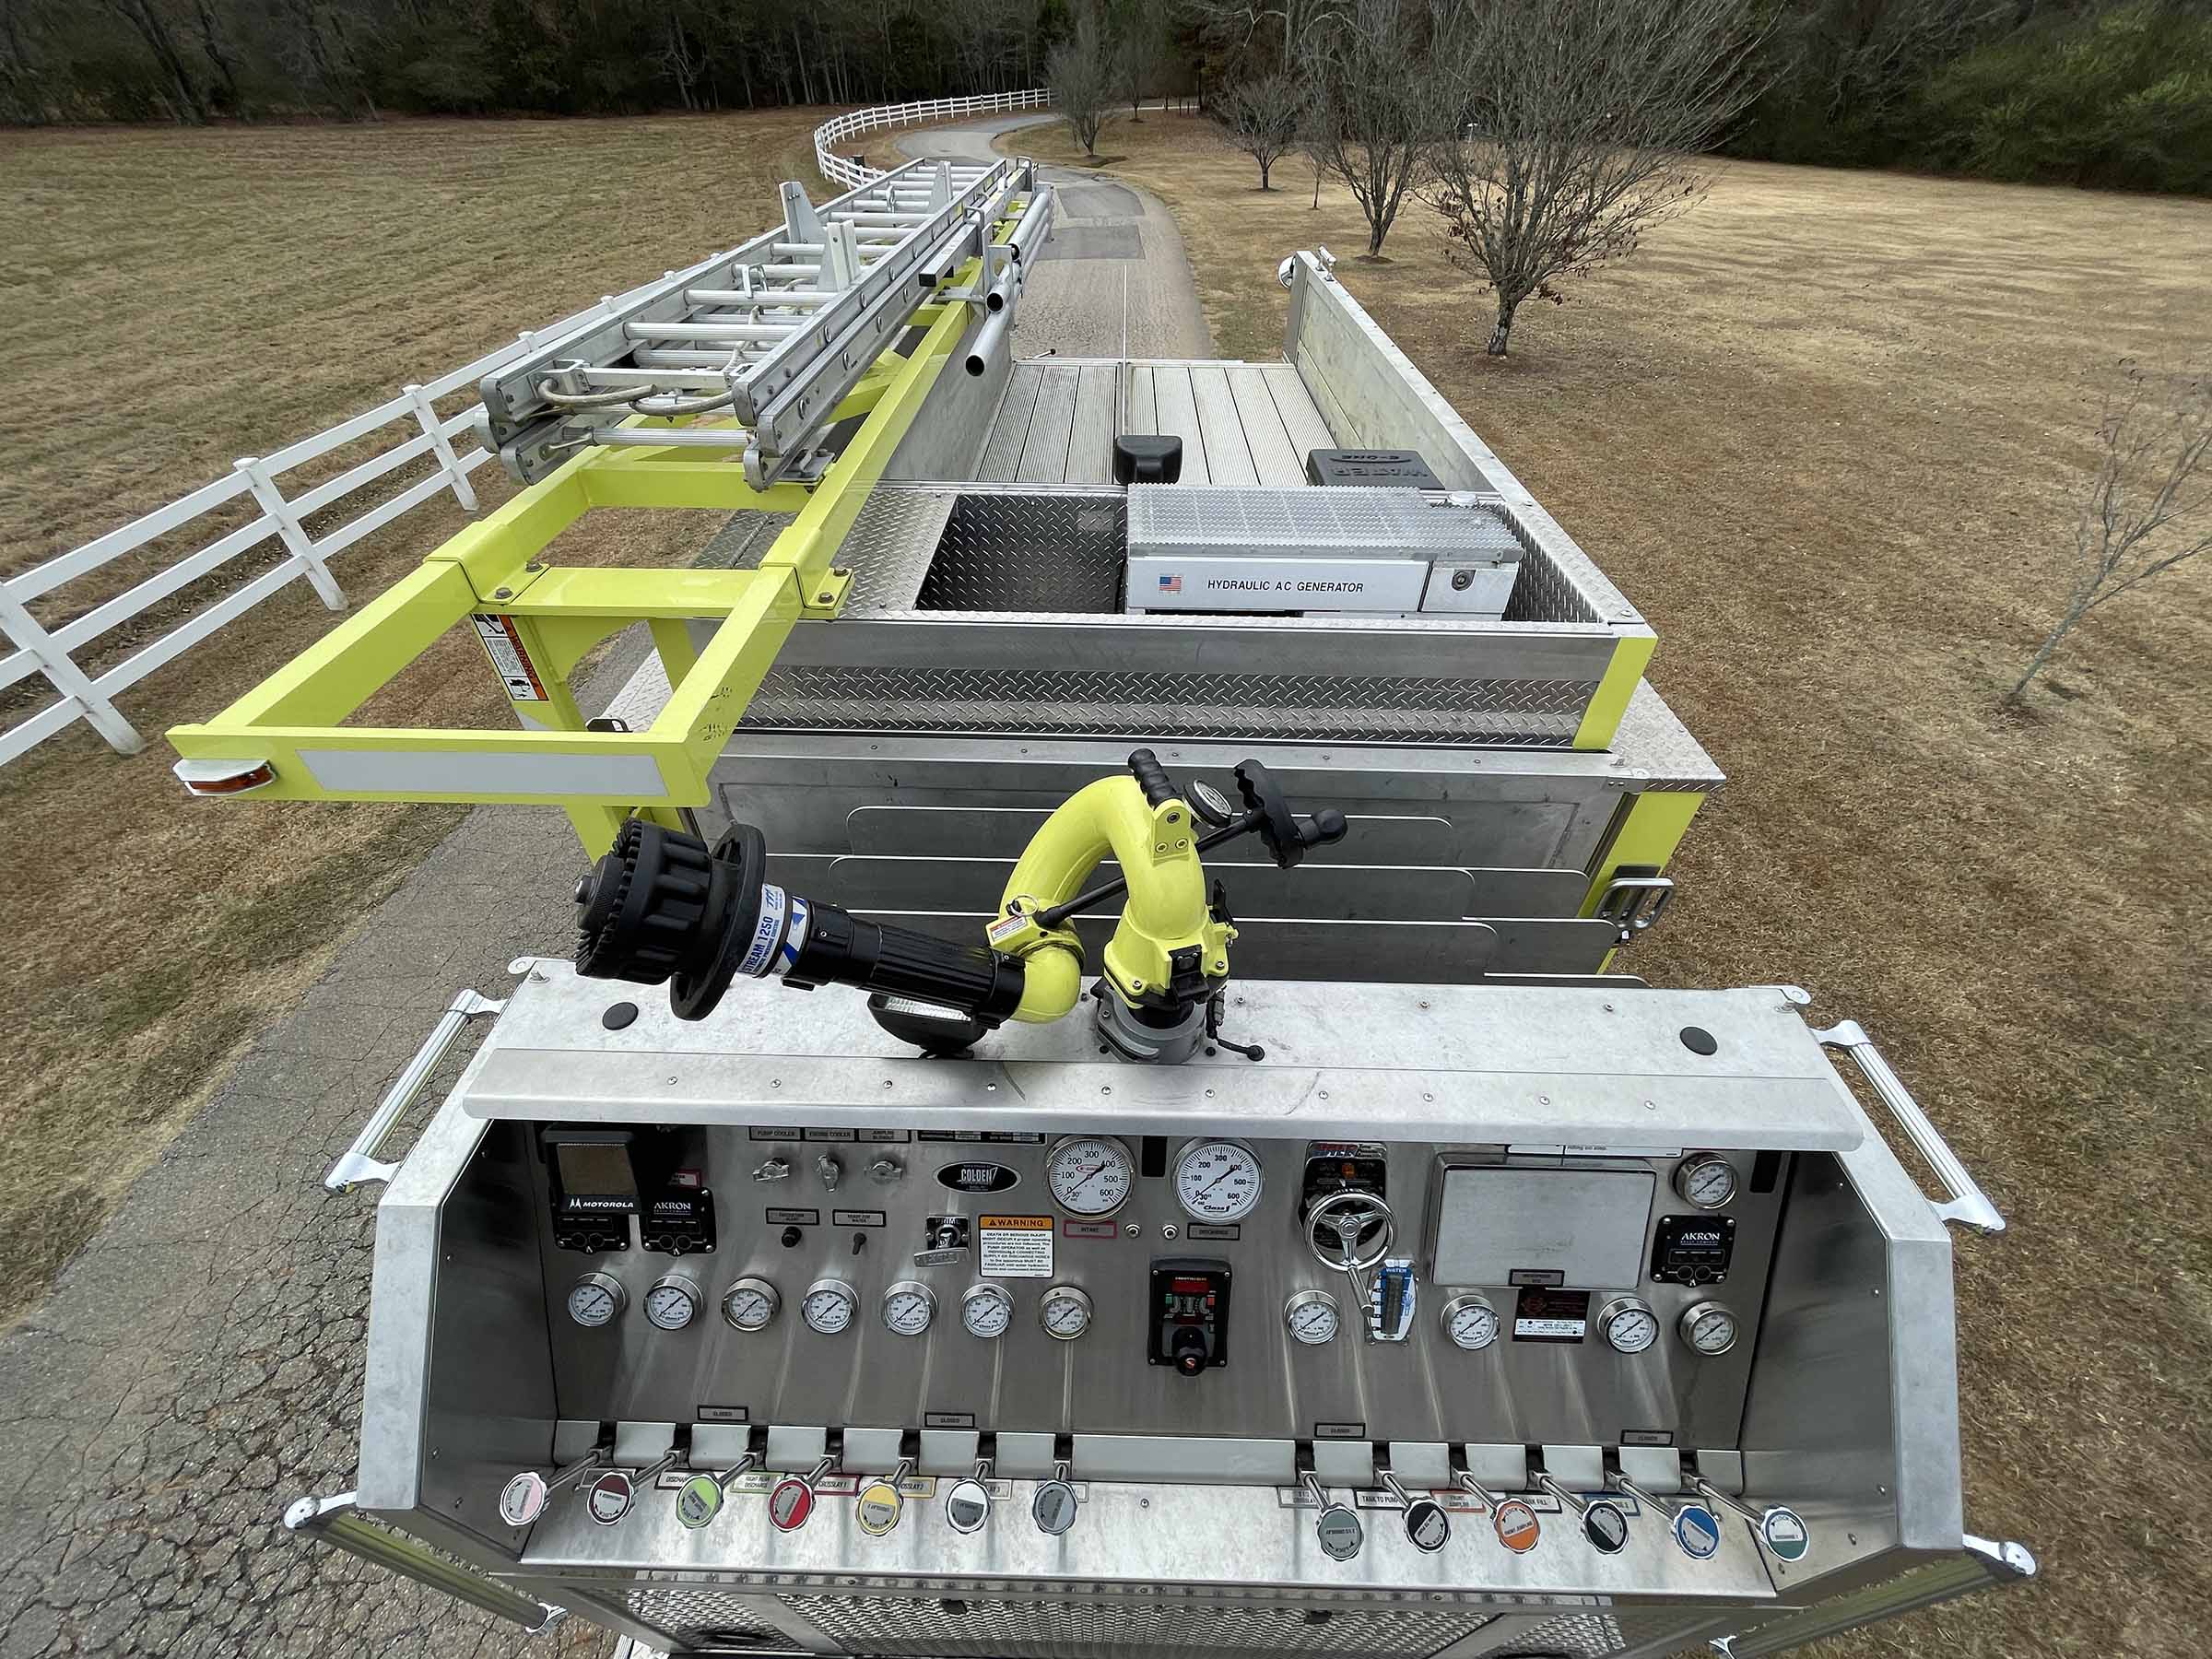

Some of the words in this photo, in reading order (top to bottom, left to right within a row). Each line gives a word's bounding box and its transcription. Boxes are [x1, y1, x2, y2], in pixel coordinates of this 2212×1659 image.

[1206, 579, 1270, 591] HYDRAULIC
[1275, 581, 1292, 591] AC
[1297, 582, 1364, 593] GENERATOR
[508, 635, 535, 679] WARNING
[741, 943, 766, 972] STREAM
[757, 916, 774, 941] 1250
[1084, 1150, 1099, 1159] 300
[1067, 1157, 1082, 1165] 200
[1103, 1175, 1118, 1183] 500
[1233, 1178, 1247, 1186] 500
[1099, 1188, 1113, 1196] 600
[653, 1202, 692, 1211] AKRON
[1681, 1232, 1721, 1241] AKRON
[1362, 1495, 1376, 1503] TANK
[1505, 1507, 1519, 1517] LOCK
